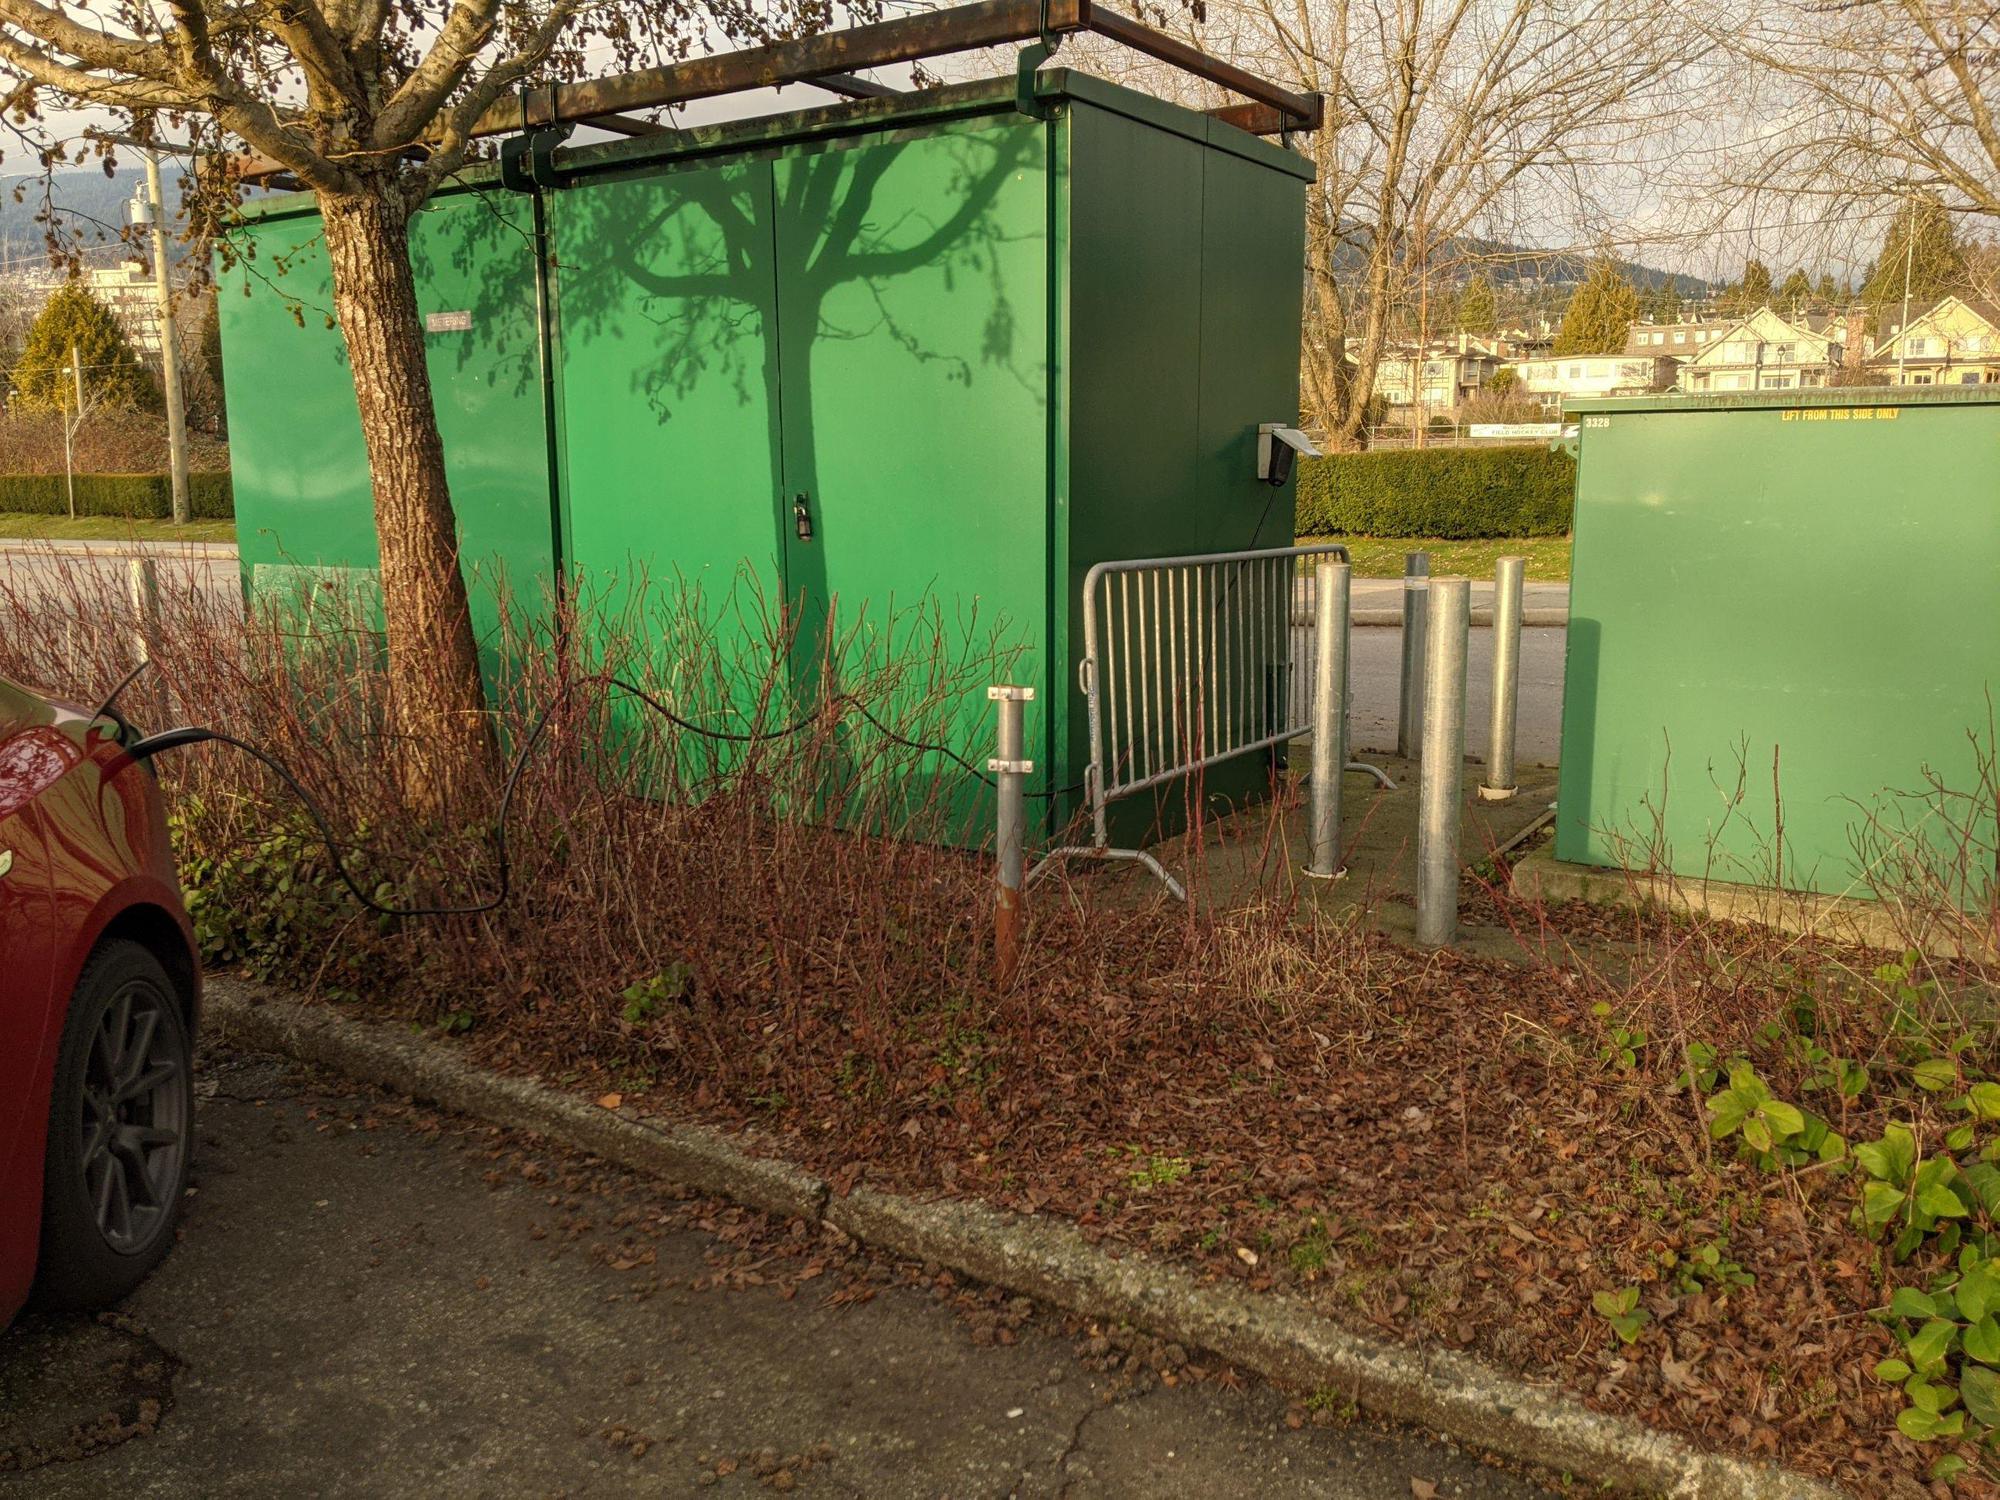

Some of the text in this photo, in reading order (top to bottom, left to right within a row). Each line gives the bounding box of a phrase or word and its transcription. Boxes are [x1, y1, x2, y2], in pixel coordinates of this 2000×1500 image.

[1781, 408, 1899, 421] LIFT FROM THIS SIDE ONLY
[1585, 417, 1610, 428] 3328
